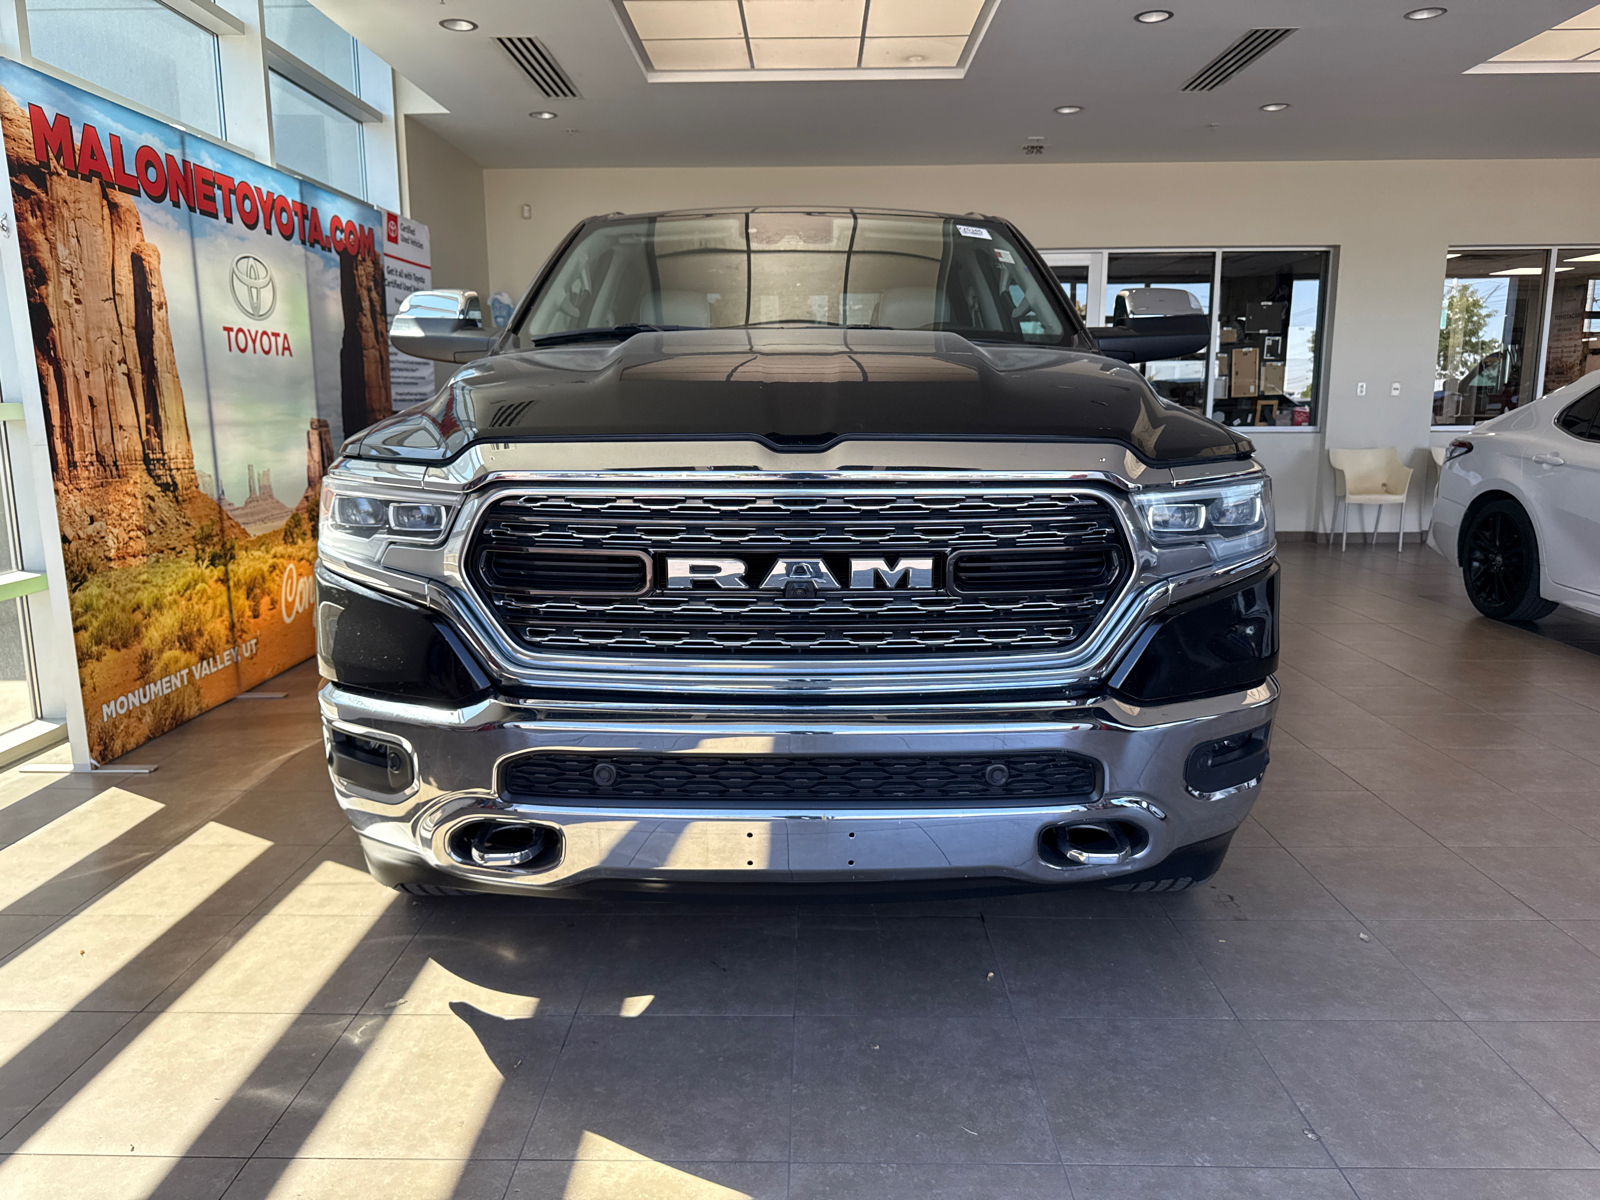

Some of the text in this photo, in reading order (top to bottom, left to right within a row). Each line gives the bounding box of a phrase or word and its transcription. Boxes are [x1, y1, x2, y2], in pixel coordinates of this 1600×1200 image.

[27, 101, 377, 261] MALONETOYOTA.COM
[222, 326, 293, 357] TOYOTA
[666, 557, 934, 589] RAM
[102, 638, 258, 722] MONUMENT VALLEY, UT
